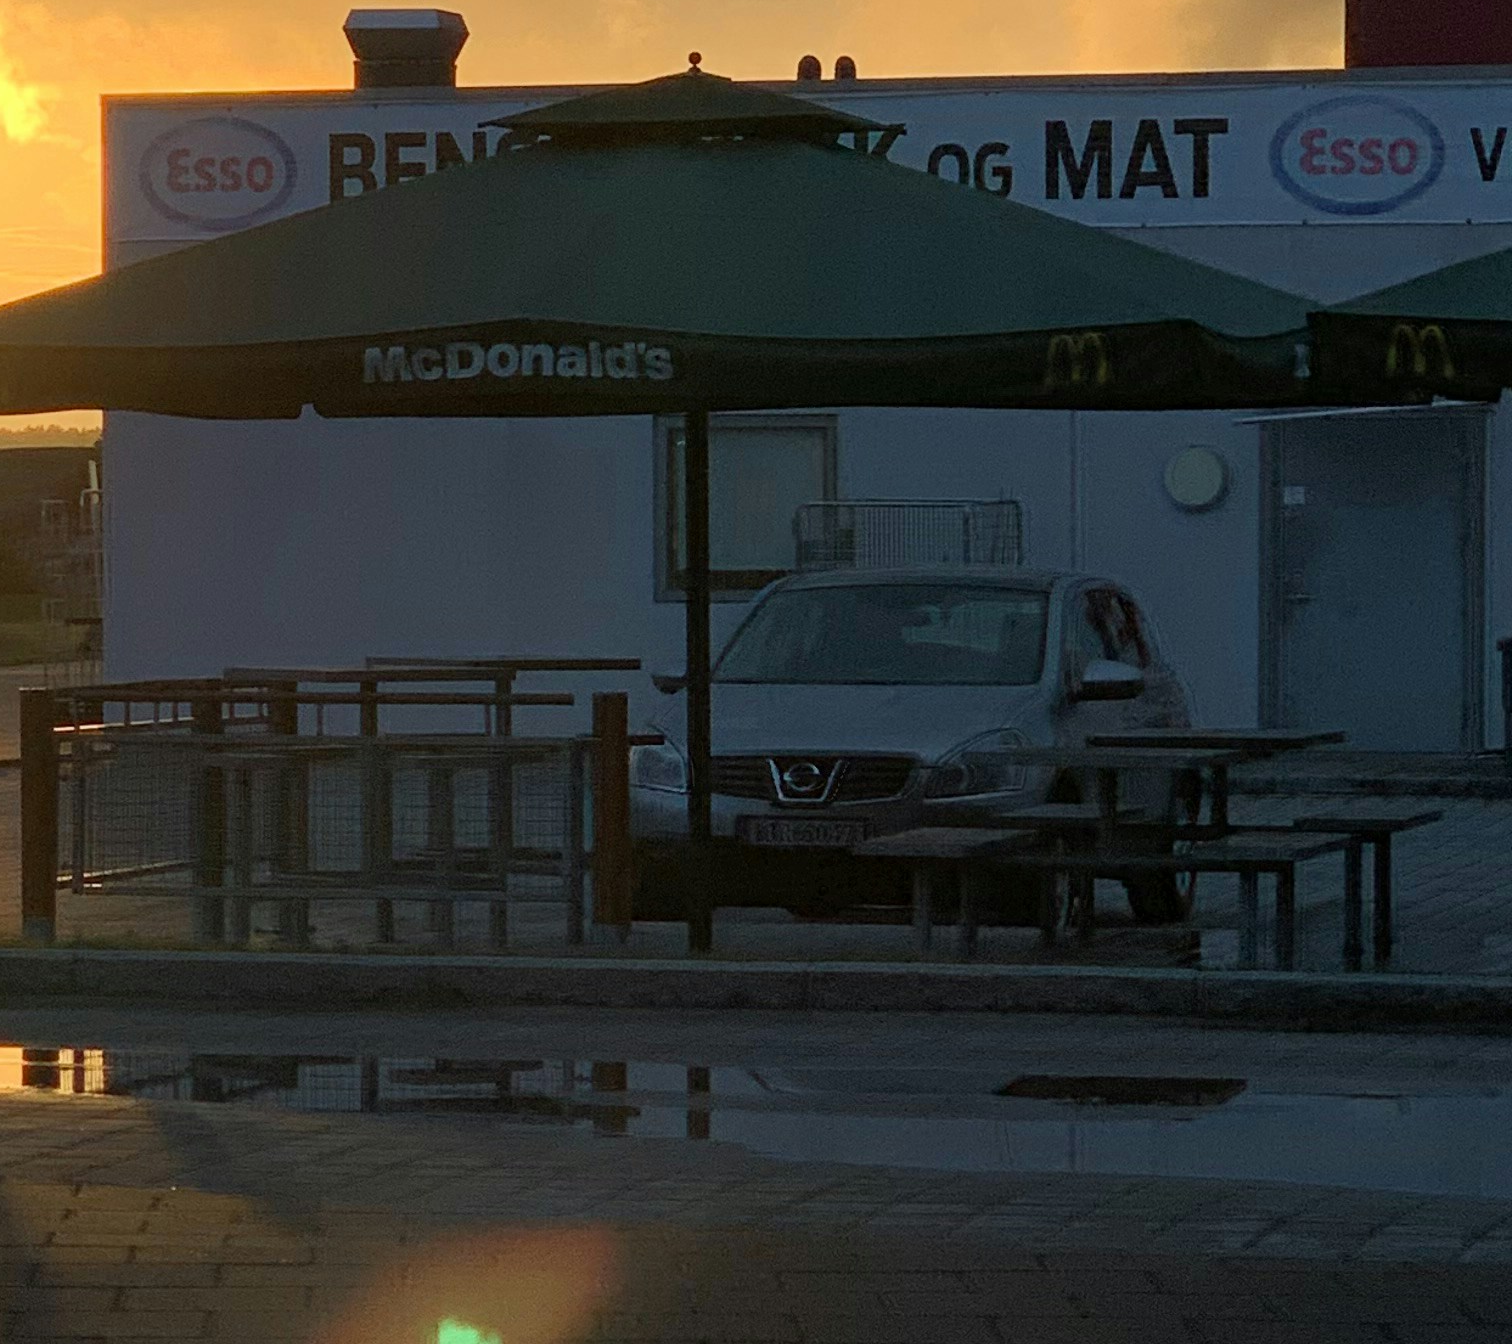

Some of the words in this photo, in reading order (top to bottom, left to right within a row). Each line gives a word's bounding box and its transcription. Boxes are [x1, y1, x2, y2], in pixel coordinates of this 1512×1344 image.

[165, 147, 275, 194] Esso
[927, 141, 1013, 198] OG
[1044, 118, 1229, 201] MAT
[1298, 129, 1418, 176] Esso
[363, 339, 675, 385] McDonald's
